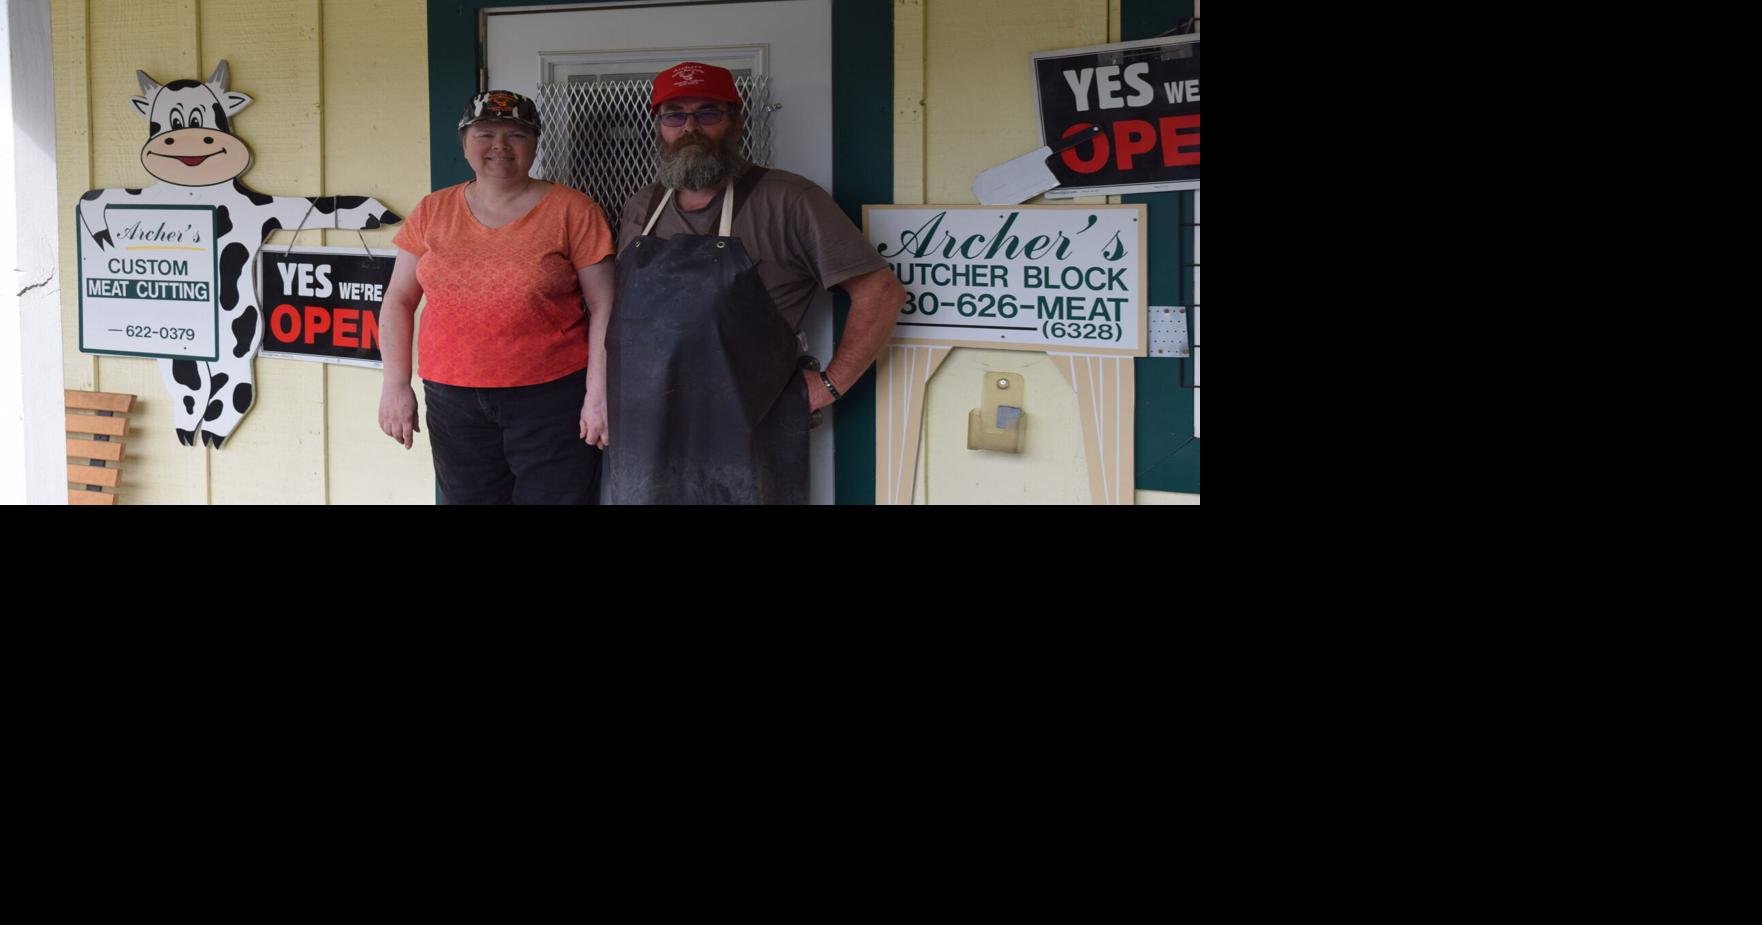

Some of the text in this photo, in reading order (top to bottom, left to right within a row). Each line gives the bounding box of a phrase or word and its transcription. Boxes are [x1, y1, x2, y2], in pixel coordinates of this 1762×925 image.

[1062, 62, 1155, 112] YES
[116, 220, 201, 243] Archer's
[877, 211, 1129, 262] Archer's
[107, 257, 189, 276] CUSTOM
[277, 261, 383, 302] YES WE'RE
[888, 262, 1129, 292] UTCHER BLOCK
[87, 279, 209, 300] MEAT CUTTING
[900, 291, 1129, 322] 30-626-MEAT
[125, 325, 196, 341] 622-0379
[269, 303, 380, 350] OPEN
[1042, 319, 1123, 342] (6328)
